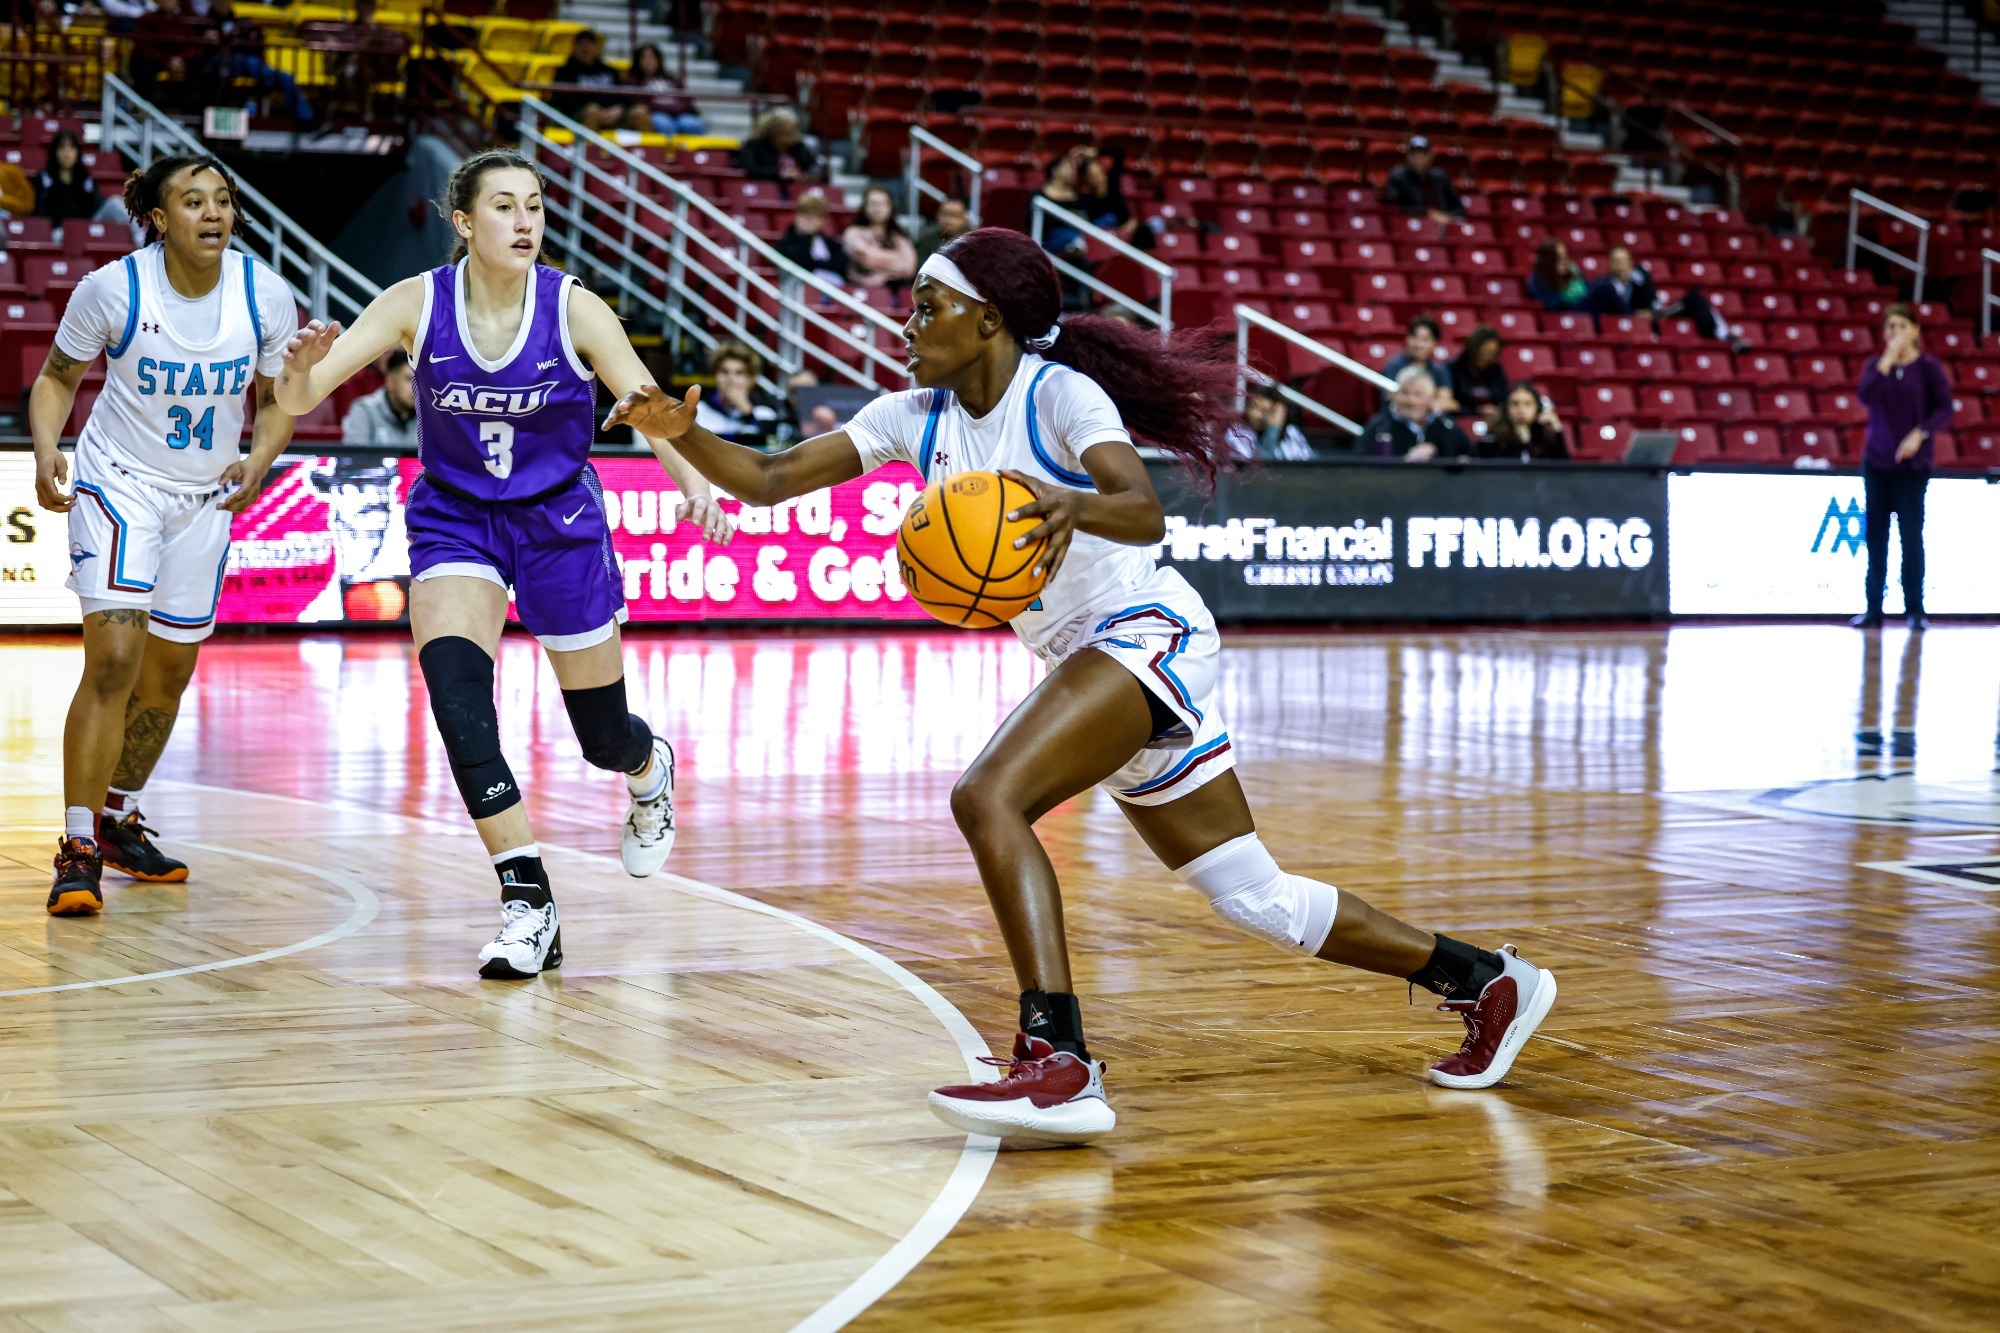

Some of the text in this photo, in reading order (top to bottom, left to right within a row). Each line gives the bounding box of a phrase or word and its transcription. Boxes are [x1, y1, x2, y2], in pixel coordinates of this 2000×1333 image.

[137, 354, 250, 396] STATE
[536, 358, 559, 371] WAC
[439, 388, 543, 414] ACU
[166, 404, 216, 451] 34
[479, 420, 515, 480] 3
[1407, 516, 1654, 569] FFNM.ORG
[614, 542, 740, 603] ride
[753, 545, 798, 602] &
